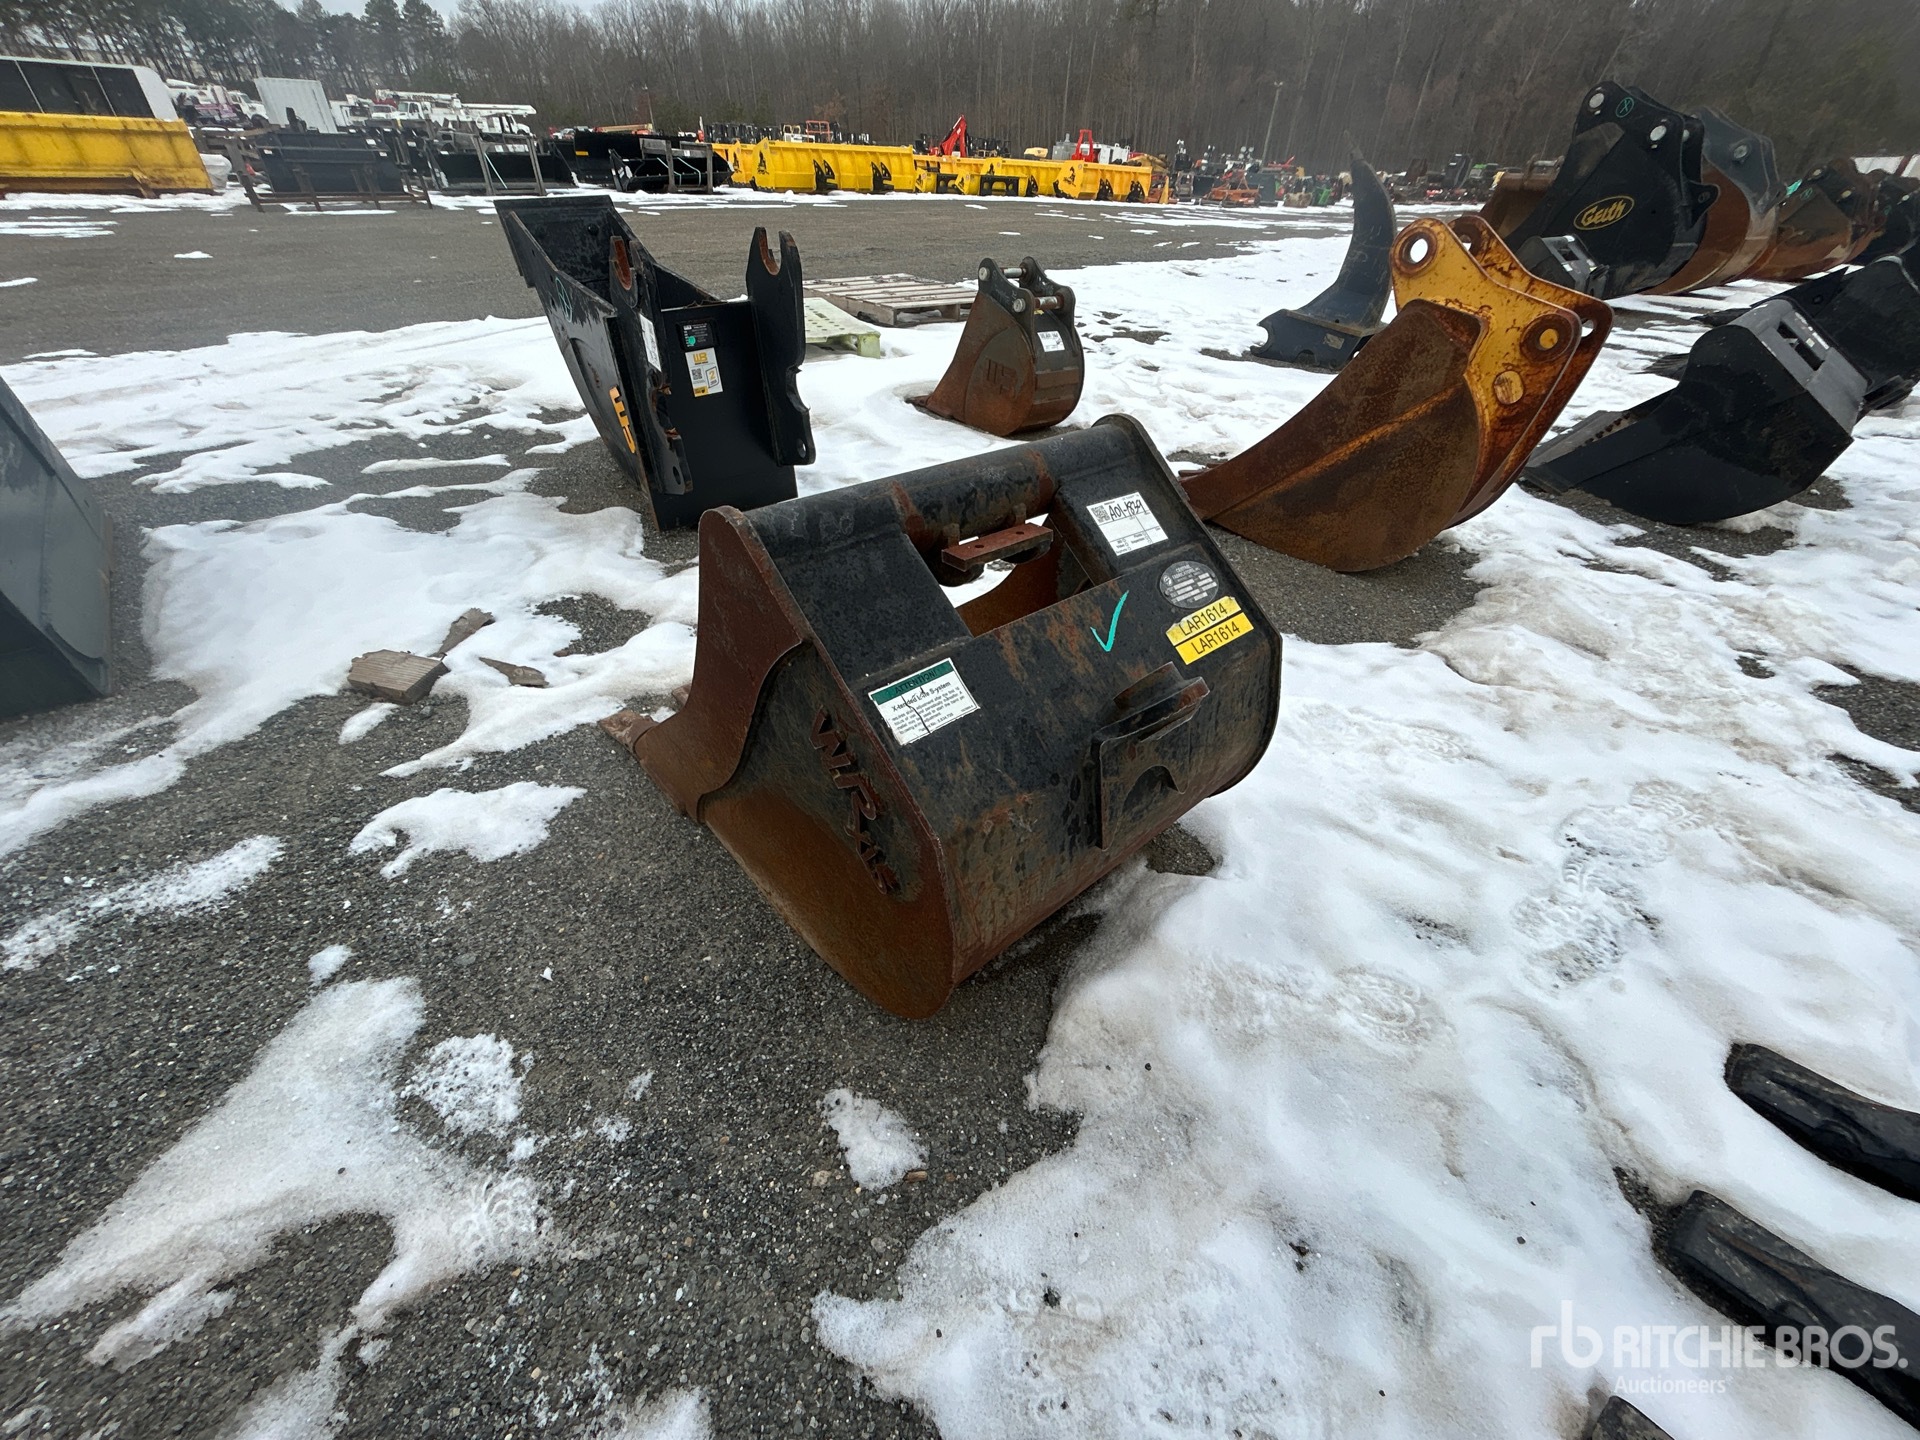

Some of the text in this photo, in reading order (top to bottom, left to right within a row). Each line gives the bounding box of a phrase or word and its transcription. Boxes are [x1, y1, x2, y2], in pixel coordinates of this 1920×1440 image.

[1178, 602, 1228, 637] LAR1614
[1191, 621, 1240, 656] LAR1614
[894, 670, 937, 693] ATTENTION!
